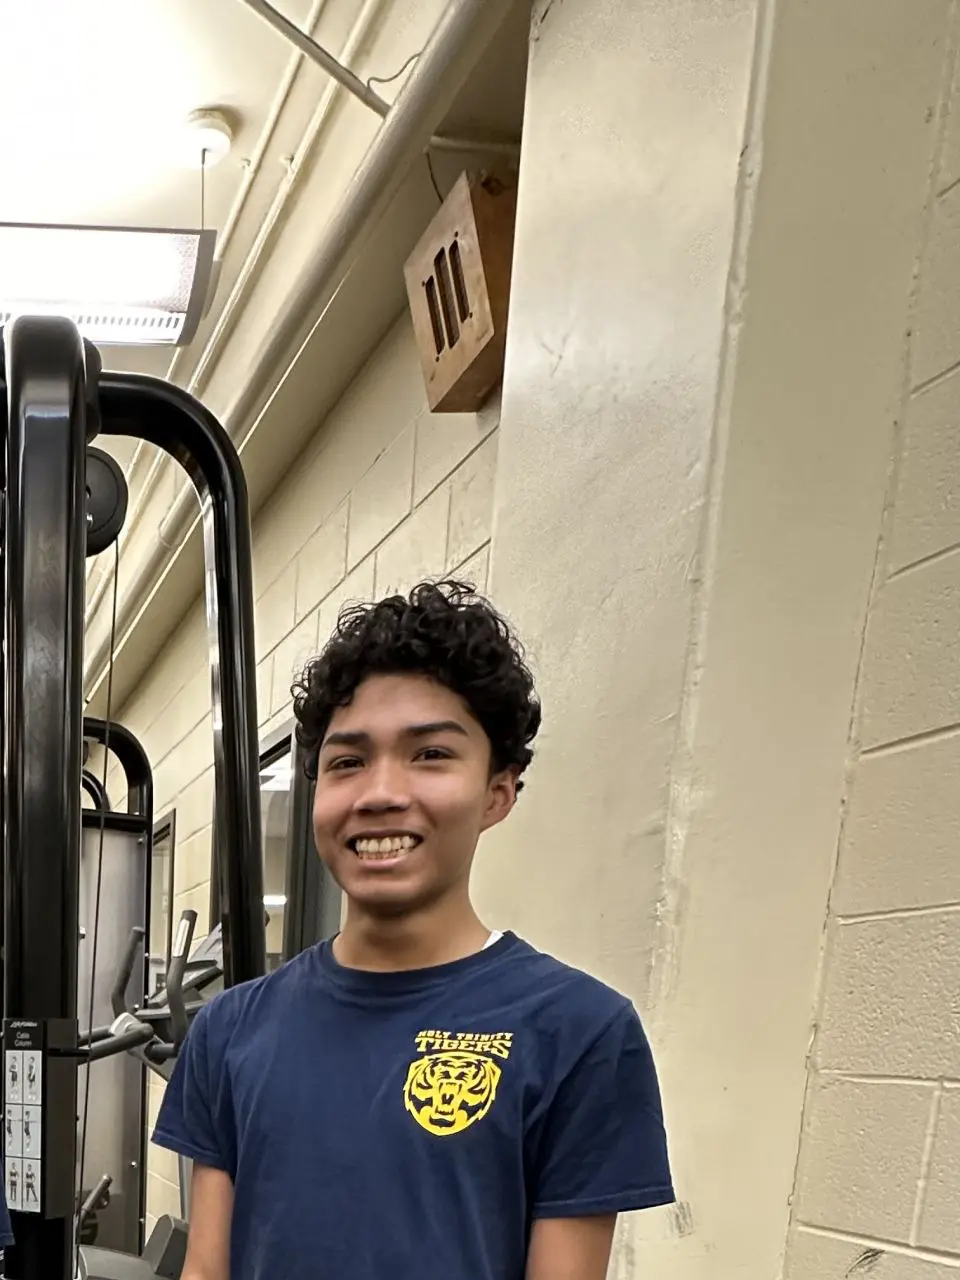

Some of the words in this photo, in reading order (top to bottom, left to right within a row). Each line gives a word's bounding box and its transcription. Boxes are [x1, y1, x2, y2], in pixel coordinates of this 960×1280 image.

[418, 1030, 452, 1039] HOLY
[456, 1032, 514, 1041] TRINITY
[414, 1037, 513, 1059] TIGERS
